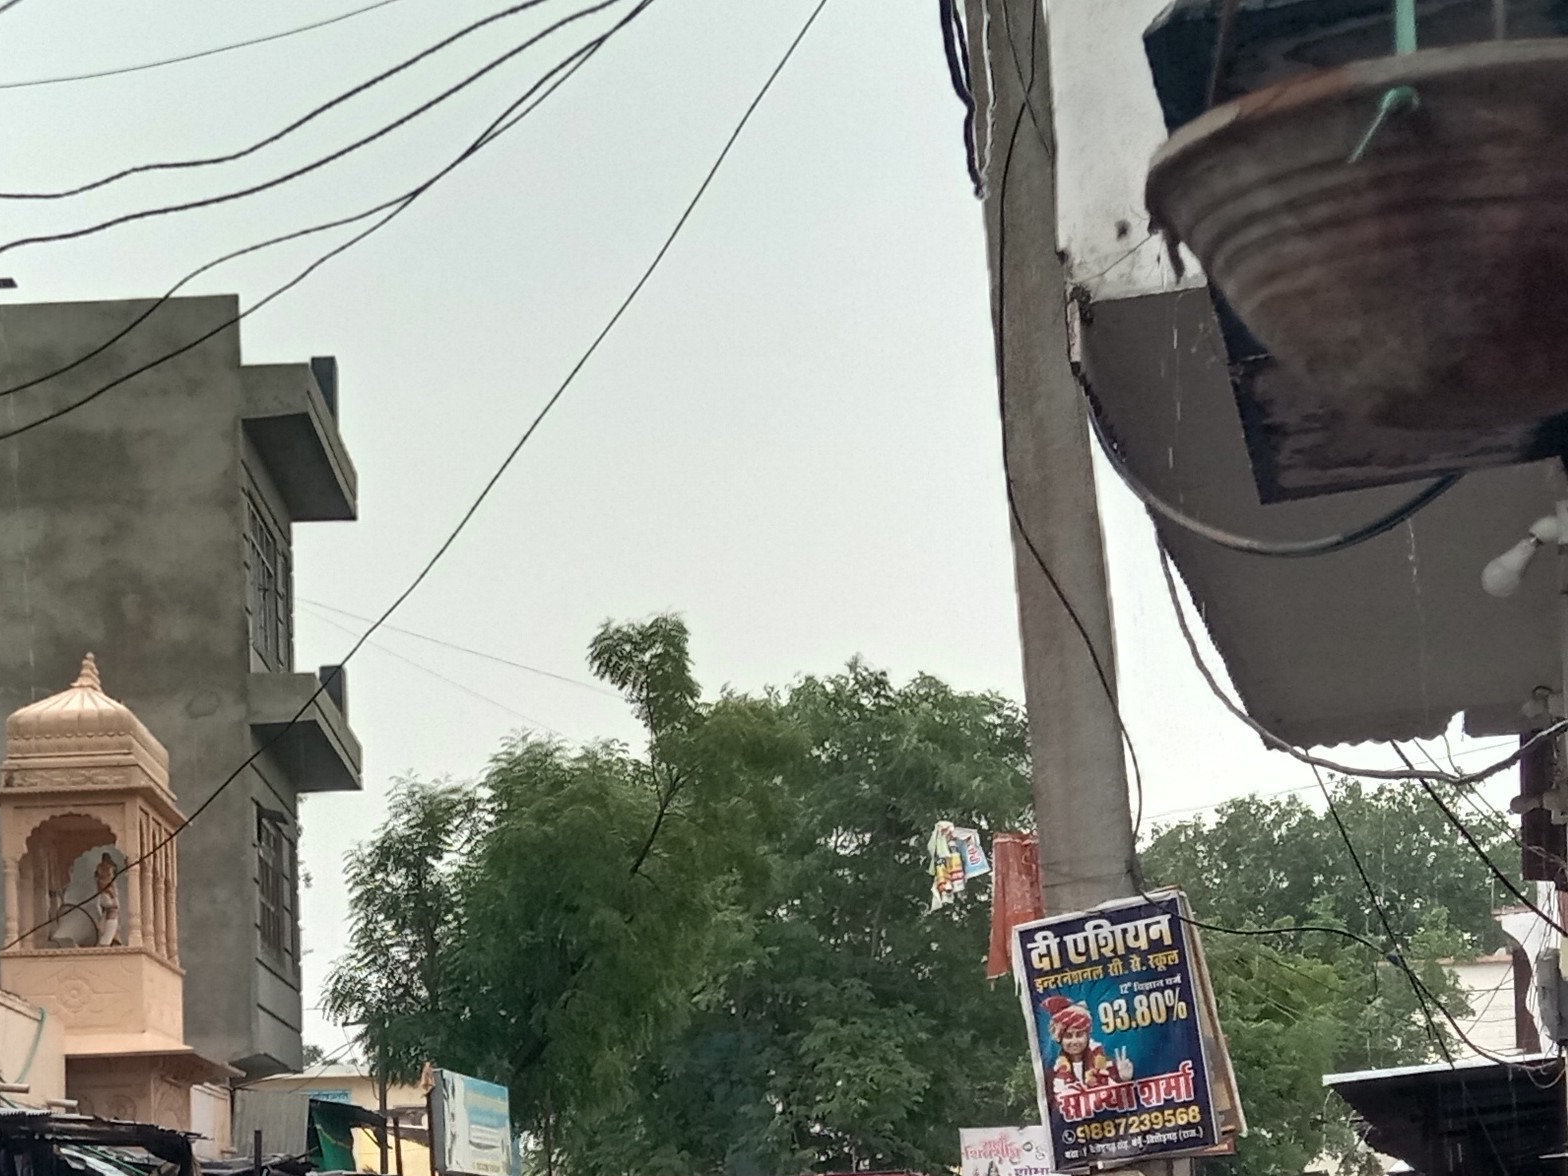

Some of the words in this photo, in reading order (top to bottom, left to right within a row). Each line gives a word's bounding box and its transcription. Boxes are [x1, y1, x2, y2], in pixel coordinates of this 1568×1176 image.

[1027, 931, 1062, 971] दी
[1063, 914, 1172, 965] एशियन
[1147, 949, 1180, 972] स्कूल
[1098, 987, 1188, 1035] 93.80%
[1136, 1060, 1195, 1107] शर्मा
[1076, 1106, 1202, 1145] 9887239568
